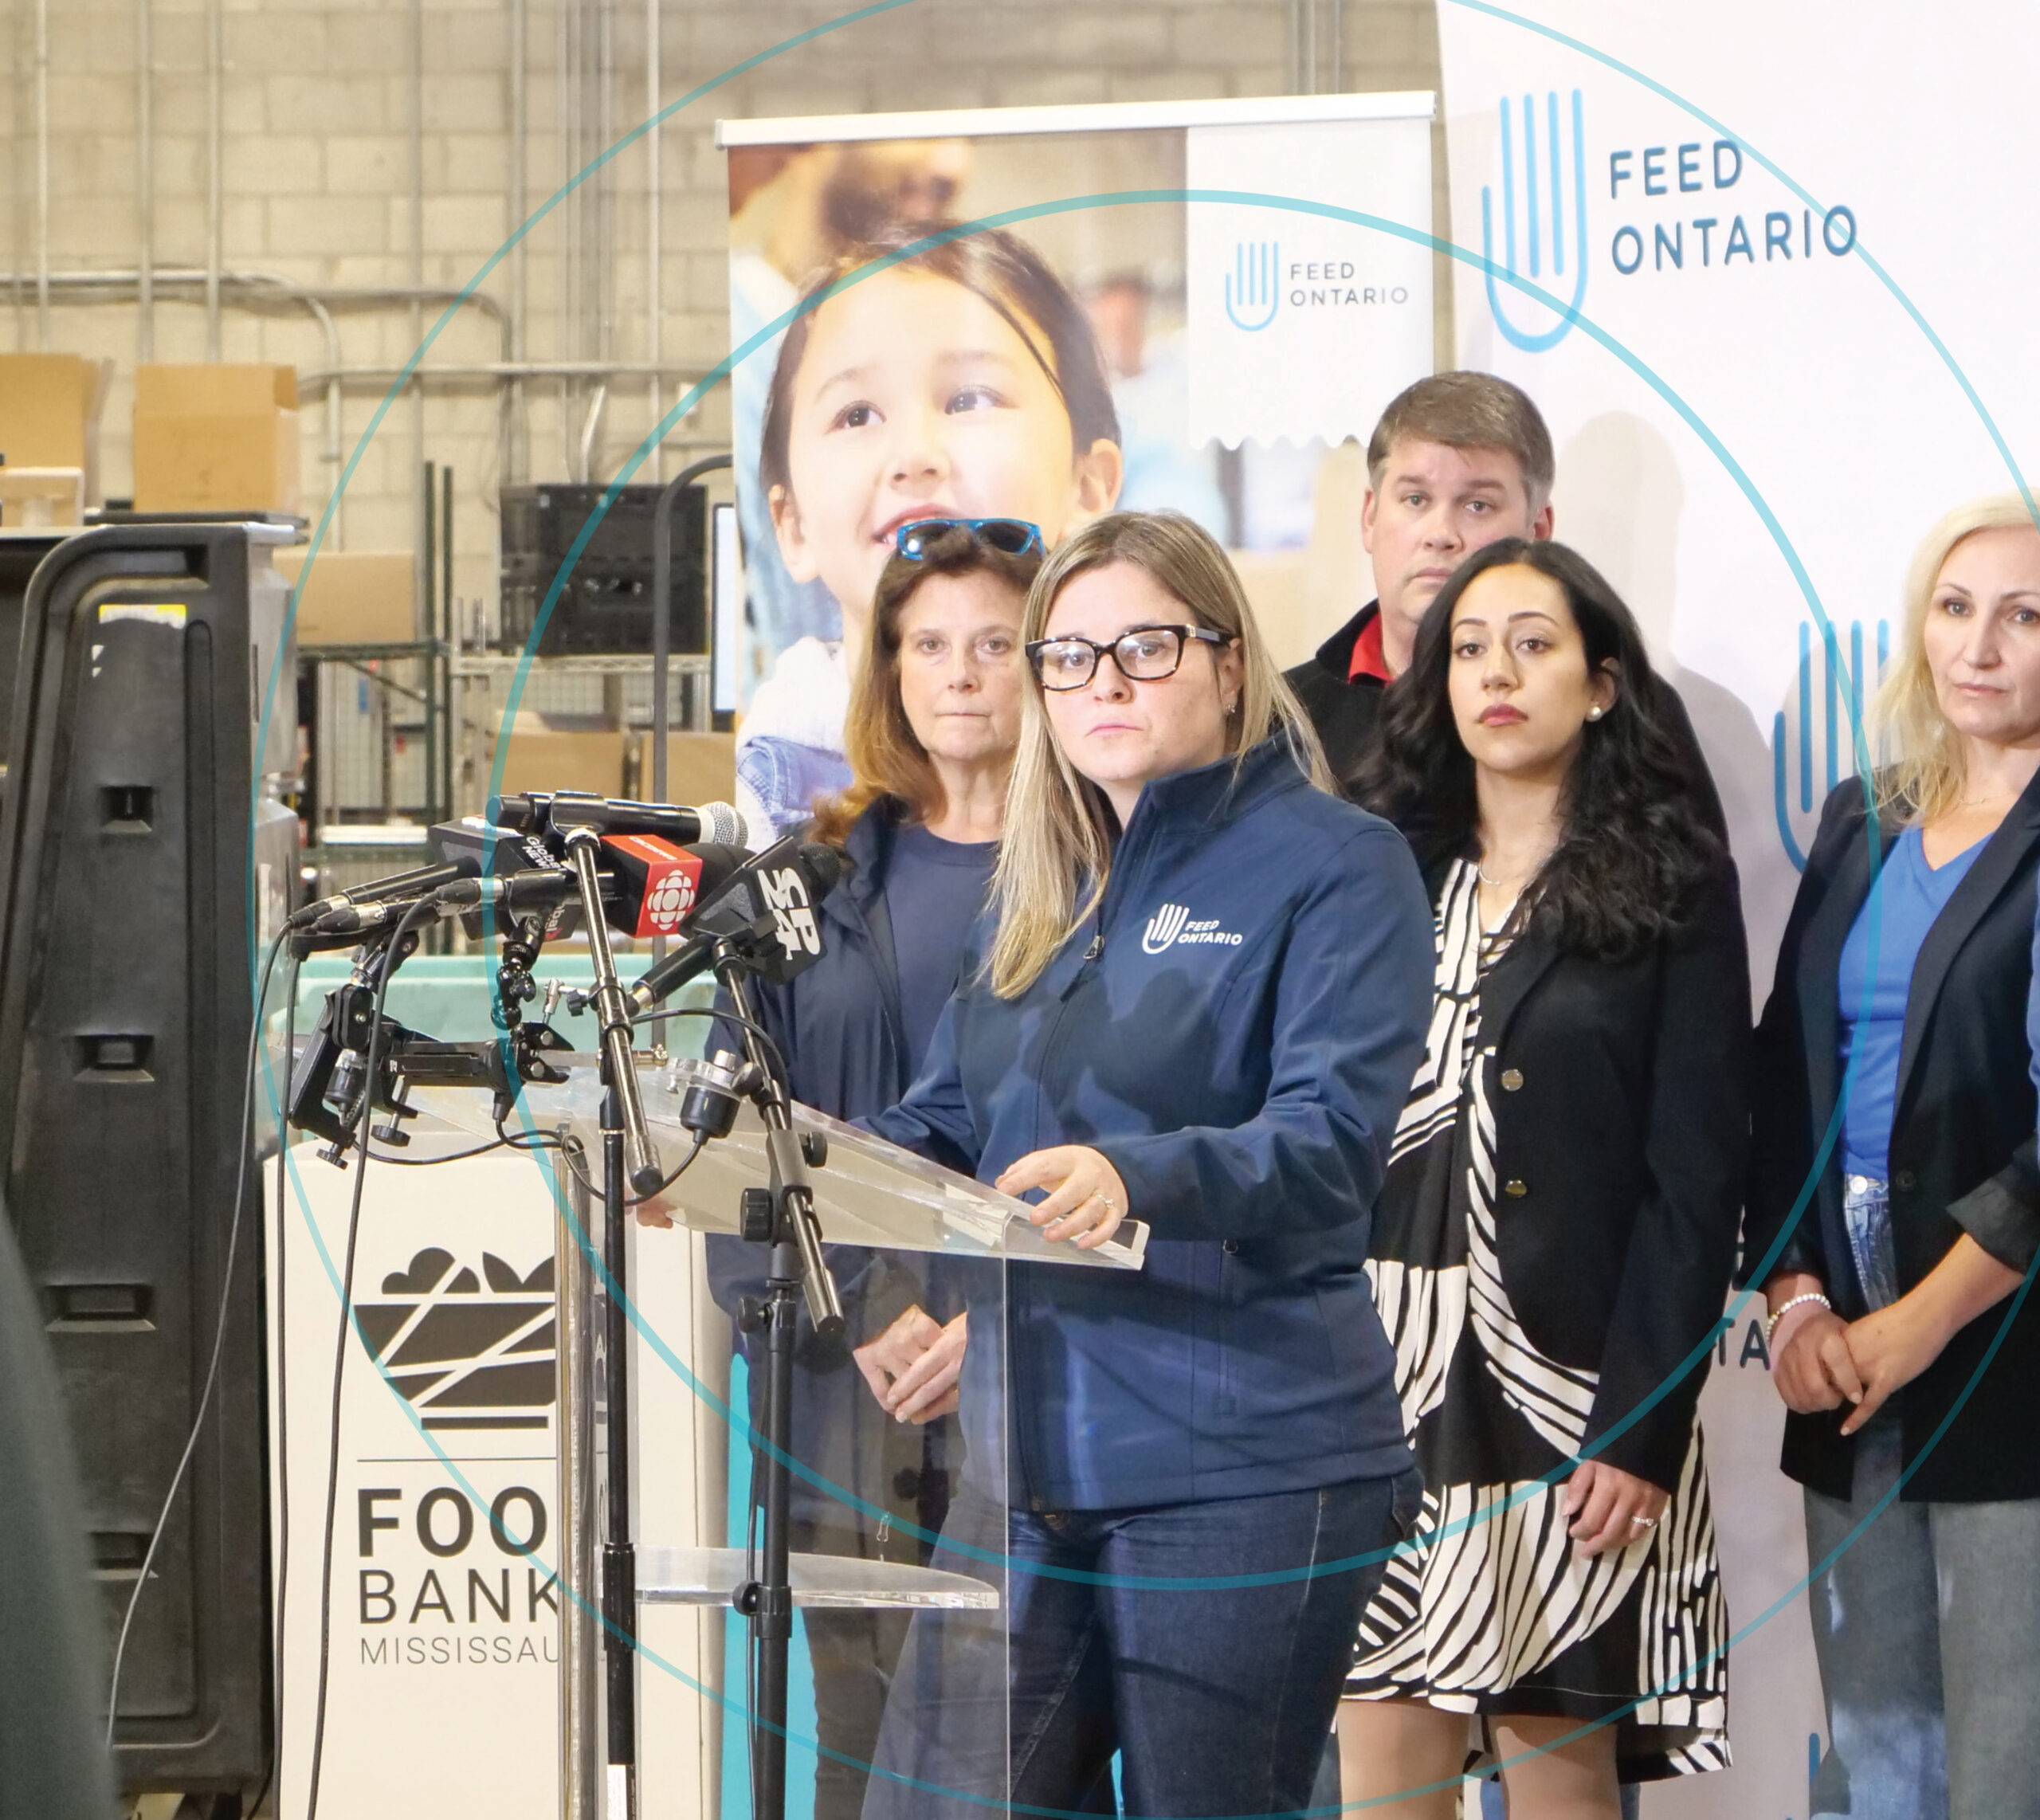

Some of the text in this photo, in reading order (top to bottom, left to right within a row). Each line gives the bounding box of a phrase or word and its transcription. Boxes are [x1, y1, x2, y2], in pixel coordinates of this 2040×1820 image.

[1610, 139, 1743, 199] FEED
[1611, 204, 1858, 276] ONTARIO
[1290, 262, 1355, 280] FEED
[1290, 287, 1409, 307] ONTARIO
[521, 845, 551, 869] NEW
[1177, 932, 1243, 946] ONTARIO
[1184, 920, 1220, 932] FEED
[357, 1485, 548, 1558] FOO
[359, 1567, 558, 1624] BANK
[360, 1636, 558, 1665] MISSISSAU
